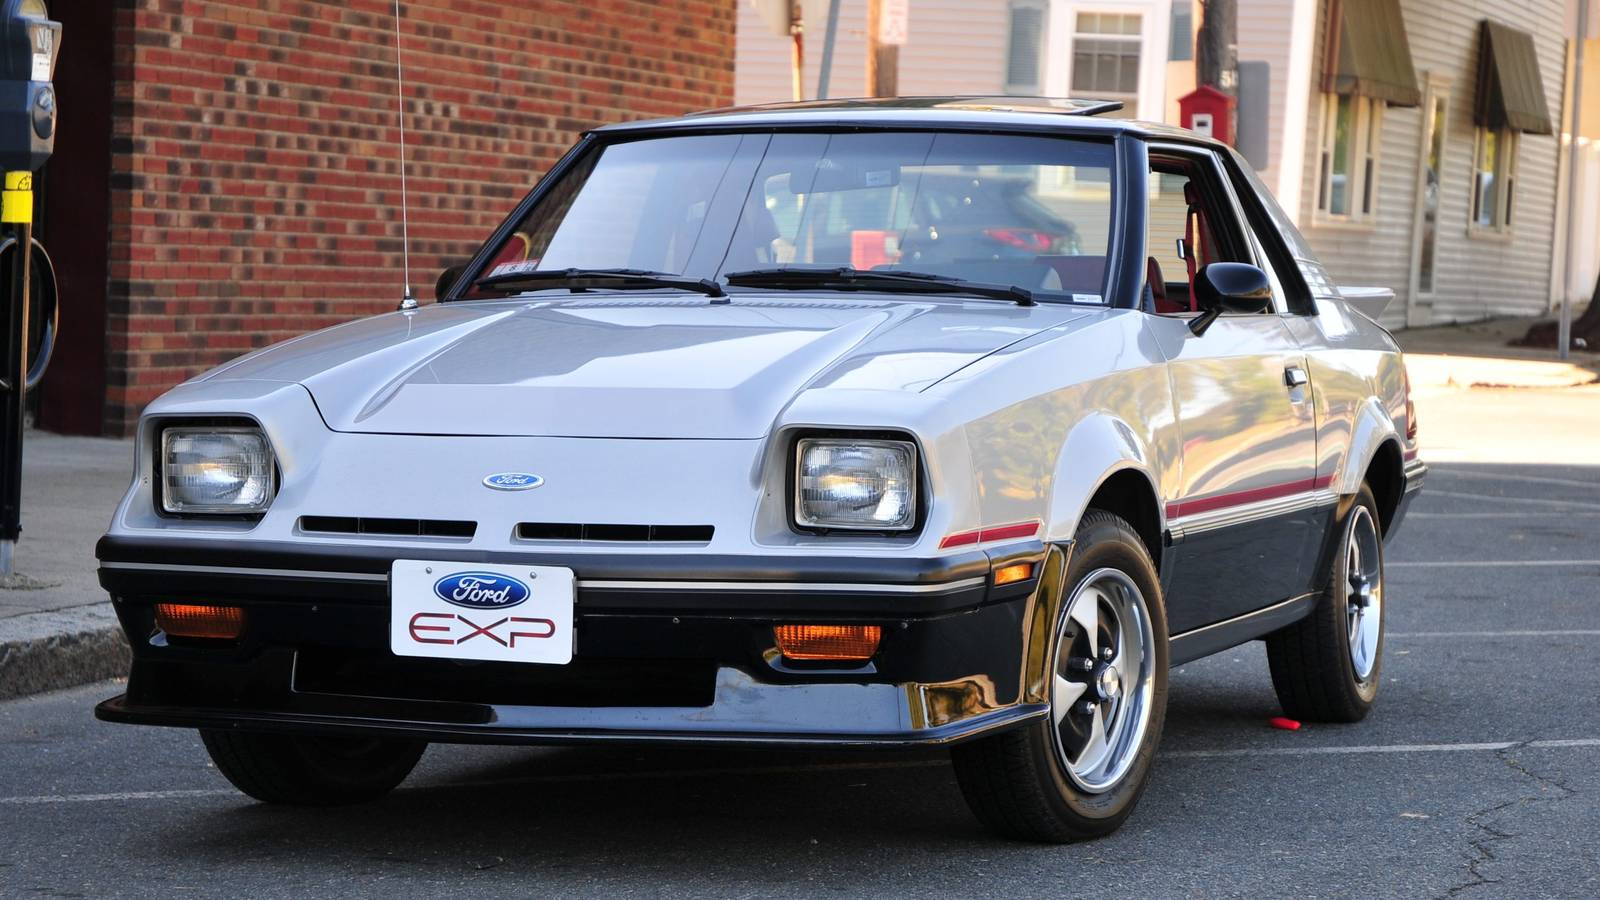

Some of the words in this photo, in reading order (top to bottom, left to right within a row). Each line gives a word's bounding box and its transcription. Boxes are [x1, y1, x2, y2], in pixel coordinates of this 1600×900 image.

[496, 474, 529, 484] Ford
[453, 576, 512, 604] Ford
[409, 612, 556, 648] EXP
